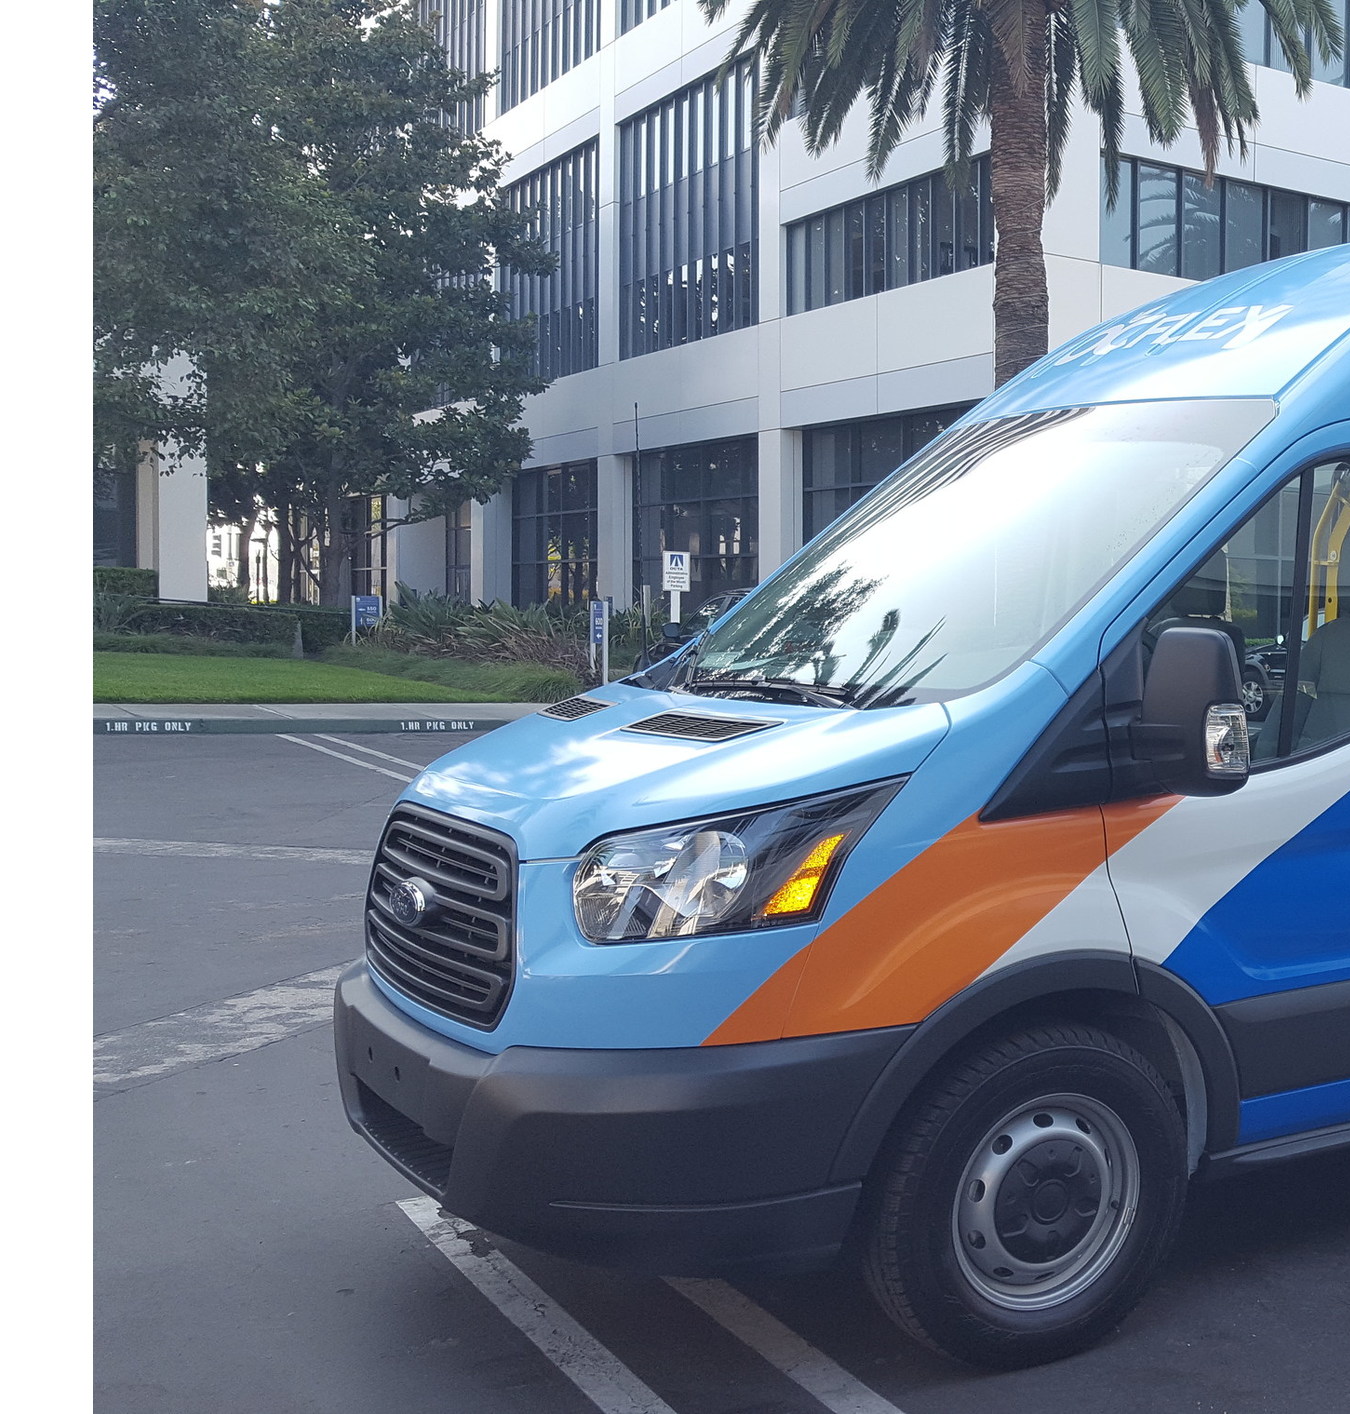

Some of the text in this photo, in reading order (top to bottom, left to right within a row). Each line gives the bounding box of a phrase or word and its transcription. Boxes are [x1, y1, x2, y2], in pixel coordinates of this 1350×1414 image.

[1050, 303, 1294, 367] OCFLEX
[135, 722, 157, 731] PKG
[164, 722, 191, 731] ONLY
[426, 721, 445, 730] PKG
[451, 721, 474, 729] ONLY
